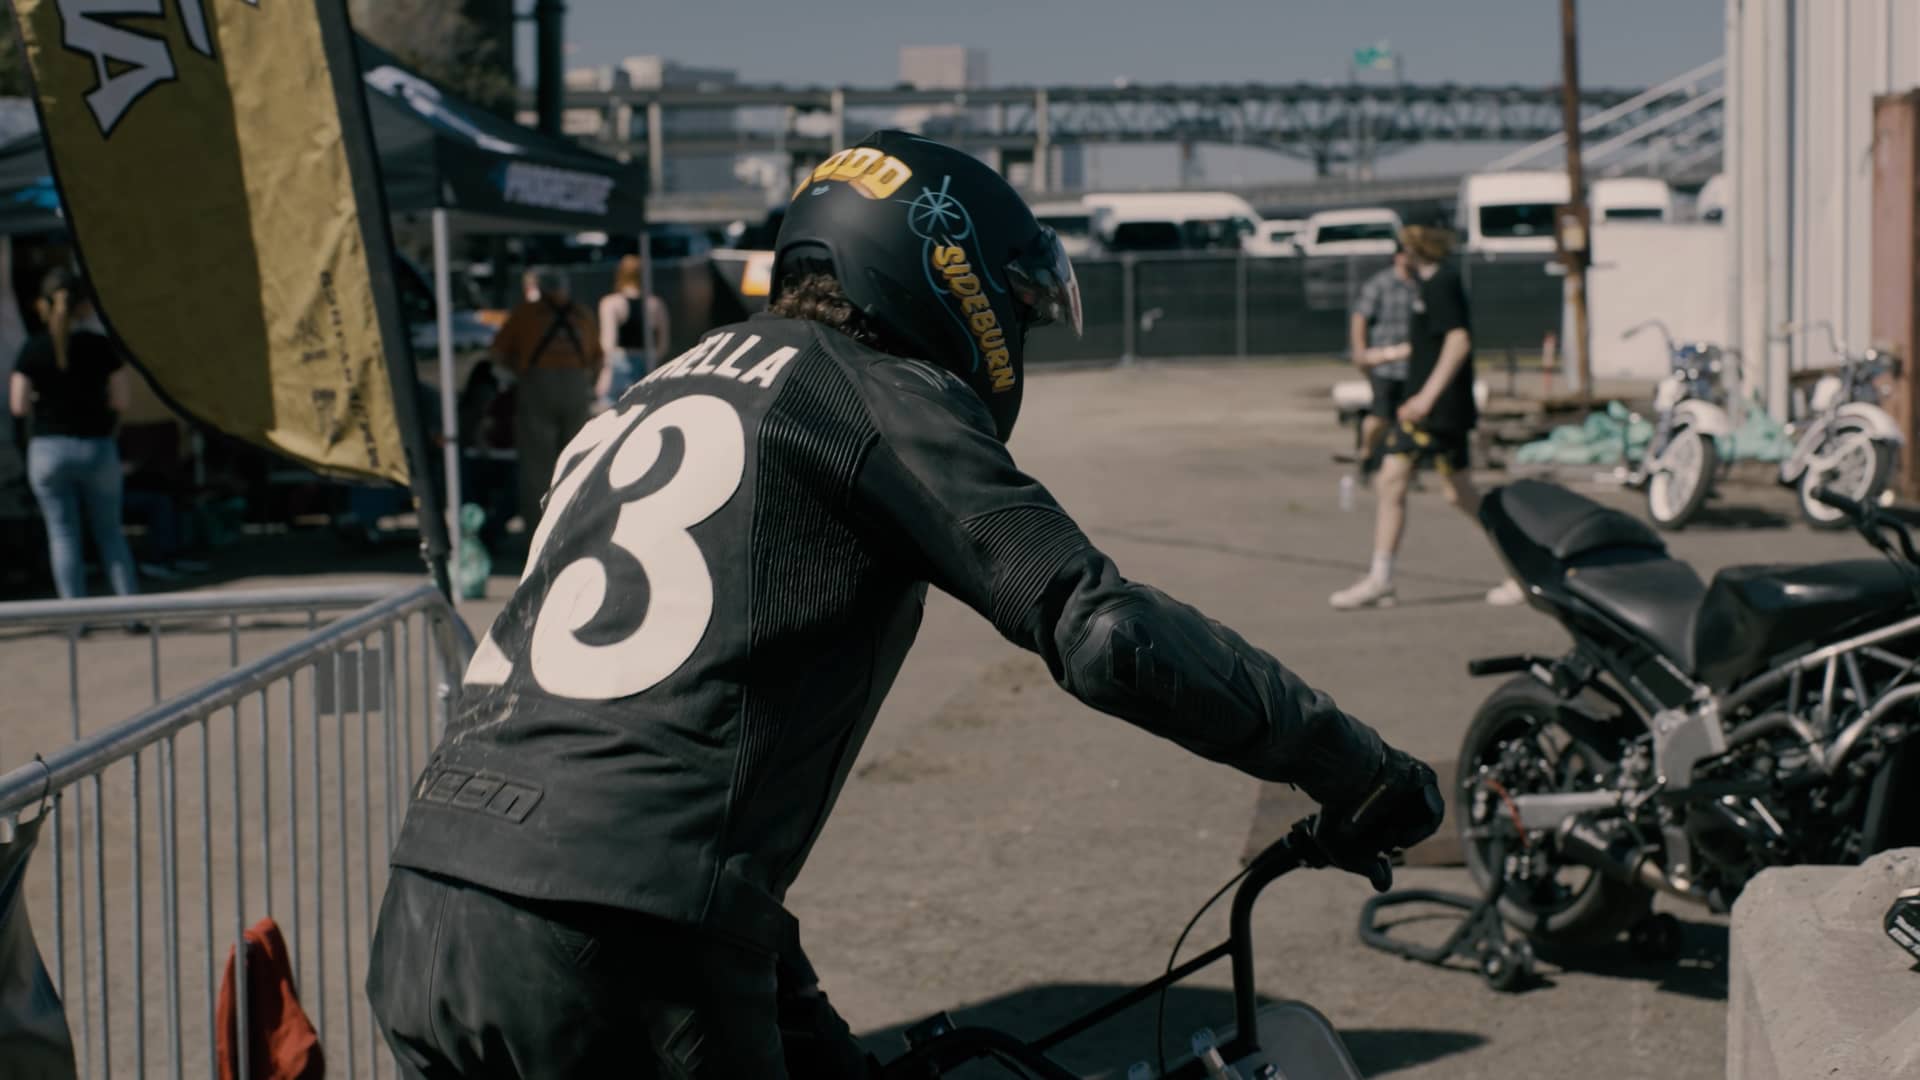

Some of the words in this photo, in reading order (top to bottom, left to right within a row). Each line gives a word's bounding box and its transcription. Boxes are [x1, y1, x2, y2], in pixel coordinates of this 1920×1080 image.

[792, 147, 913, 200] ODD
[932, 245, 1016, 394] SIDEBURN
[463, 395, 746, 700] 73
